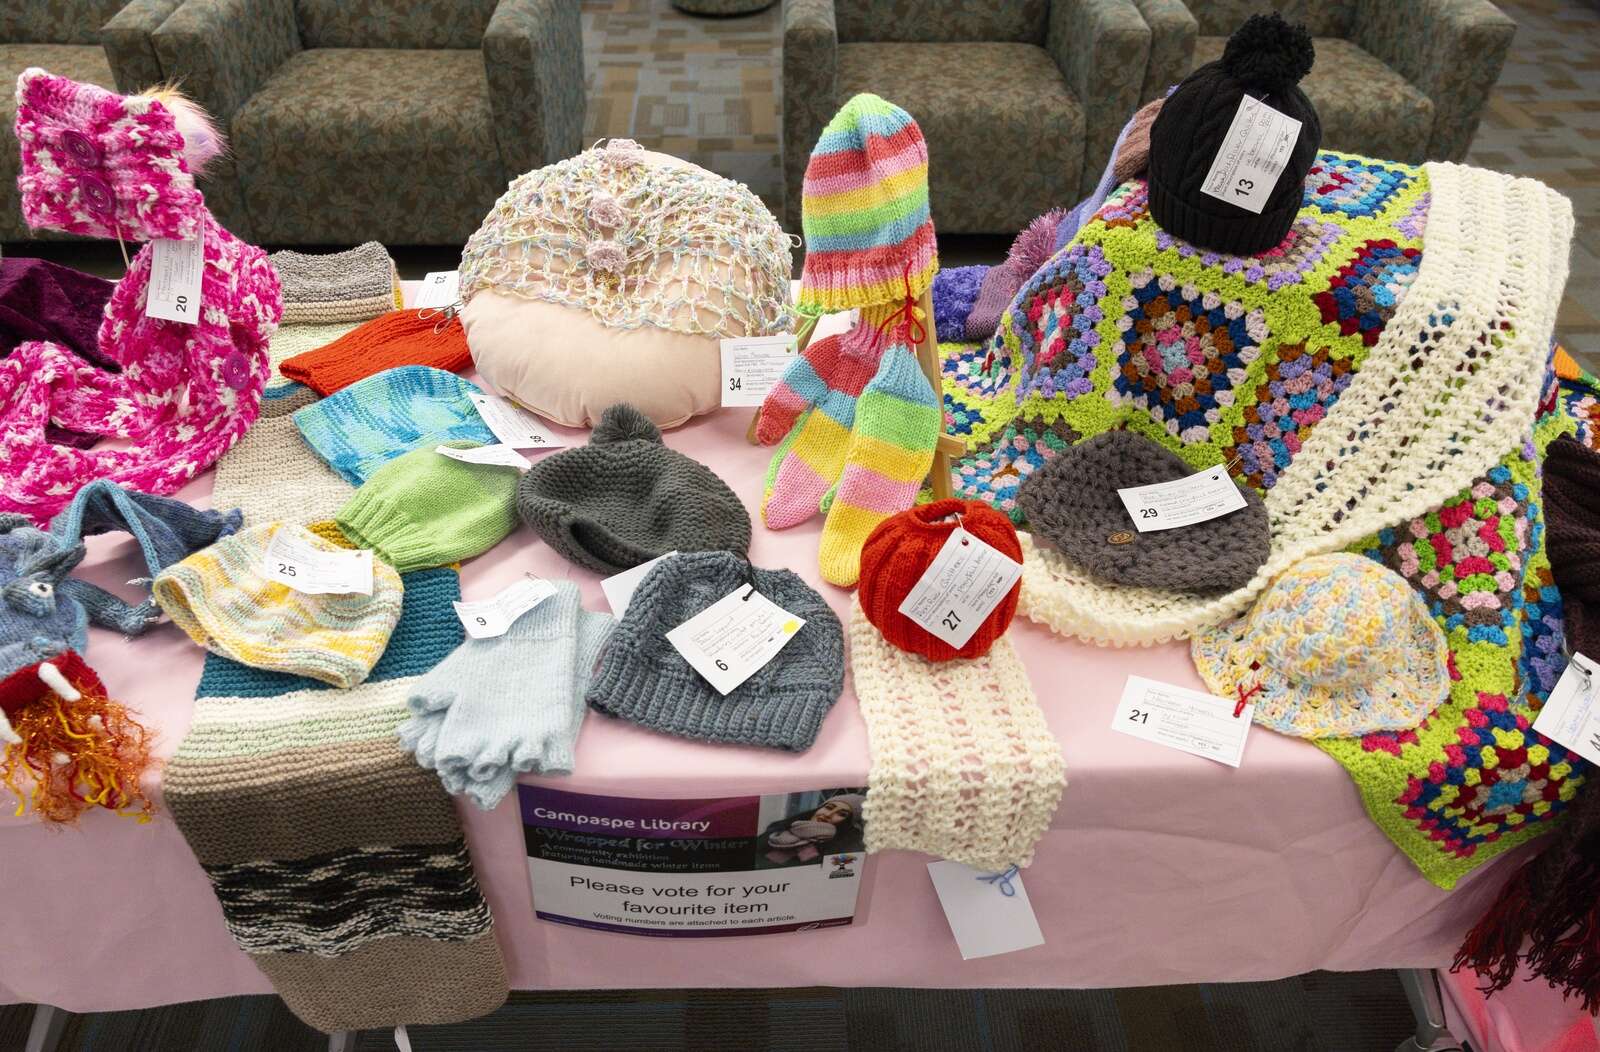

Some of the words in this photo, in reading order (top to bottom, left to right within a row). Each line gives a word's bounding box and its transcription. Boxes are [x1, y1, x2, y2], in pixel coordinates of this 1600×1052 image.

[1235, 178, 1254, 197] 13
[176, 295, 188, 313] 20
[729, 376, 742, 392] 34
[1139, 507, 1159, 519] 29
[278, 562, 297, 577] 25
[475, 616, 488, 626] 9
[941, 610, 963, 631] 27
[714, 658, 729, 672] 6
[1128, 709, 1149, 725] 21
[533, 806, 636, 829] Campaspe
[639, 818, 712, 833] Library
[535, 827, 630, 848] Wrapped
[635, 838, 665, 851] for
[670, 838, 749, 851] Winter
[541, 849, 592, 864] featuring
[592, 855, 648, 869] handmade
[570, 876, 645, 896] Please
[652, 886, 698, 897] vote
[707, 884, 736, 897] for
[742, 882, 791, 898] your
[622, 900, 716, 915] favourite
[724, 902, 768, 914] item
[592, 911, 623, 922] Voting
[625, 917, 667, 926] numbers
[686, 918, 728, 926] attached
